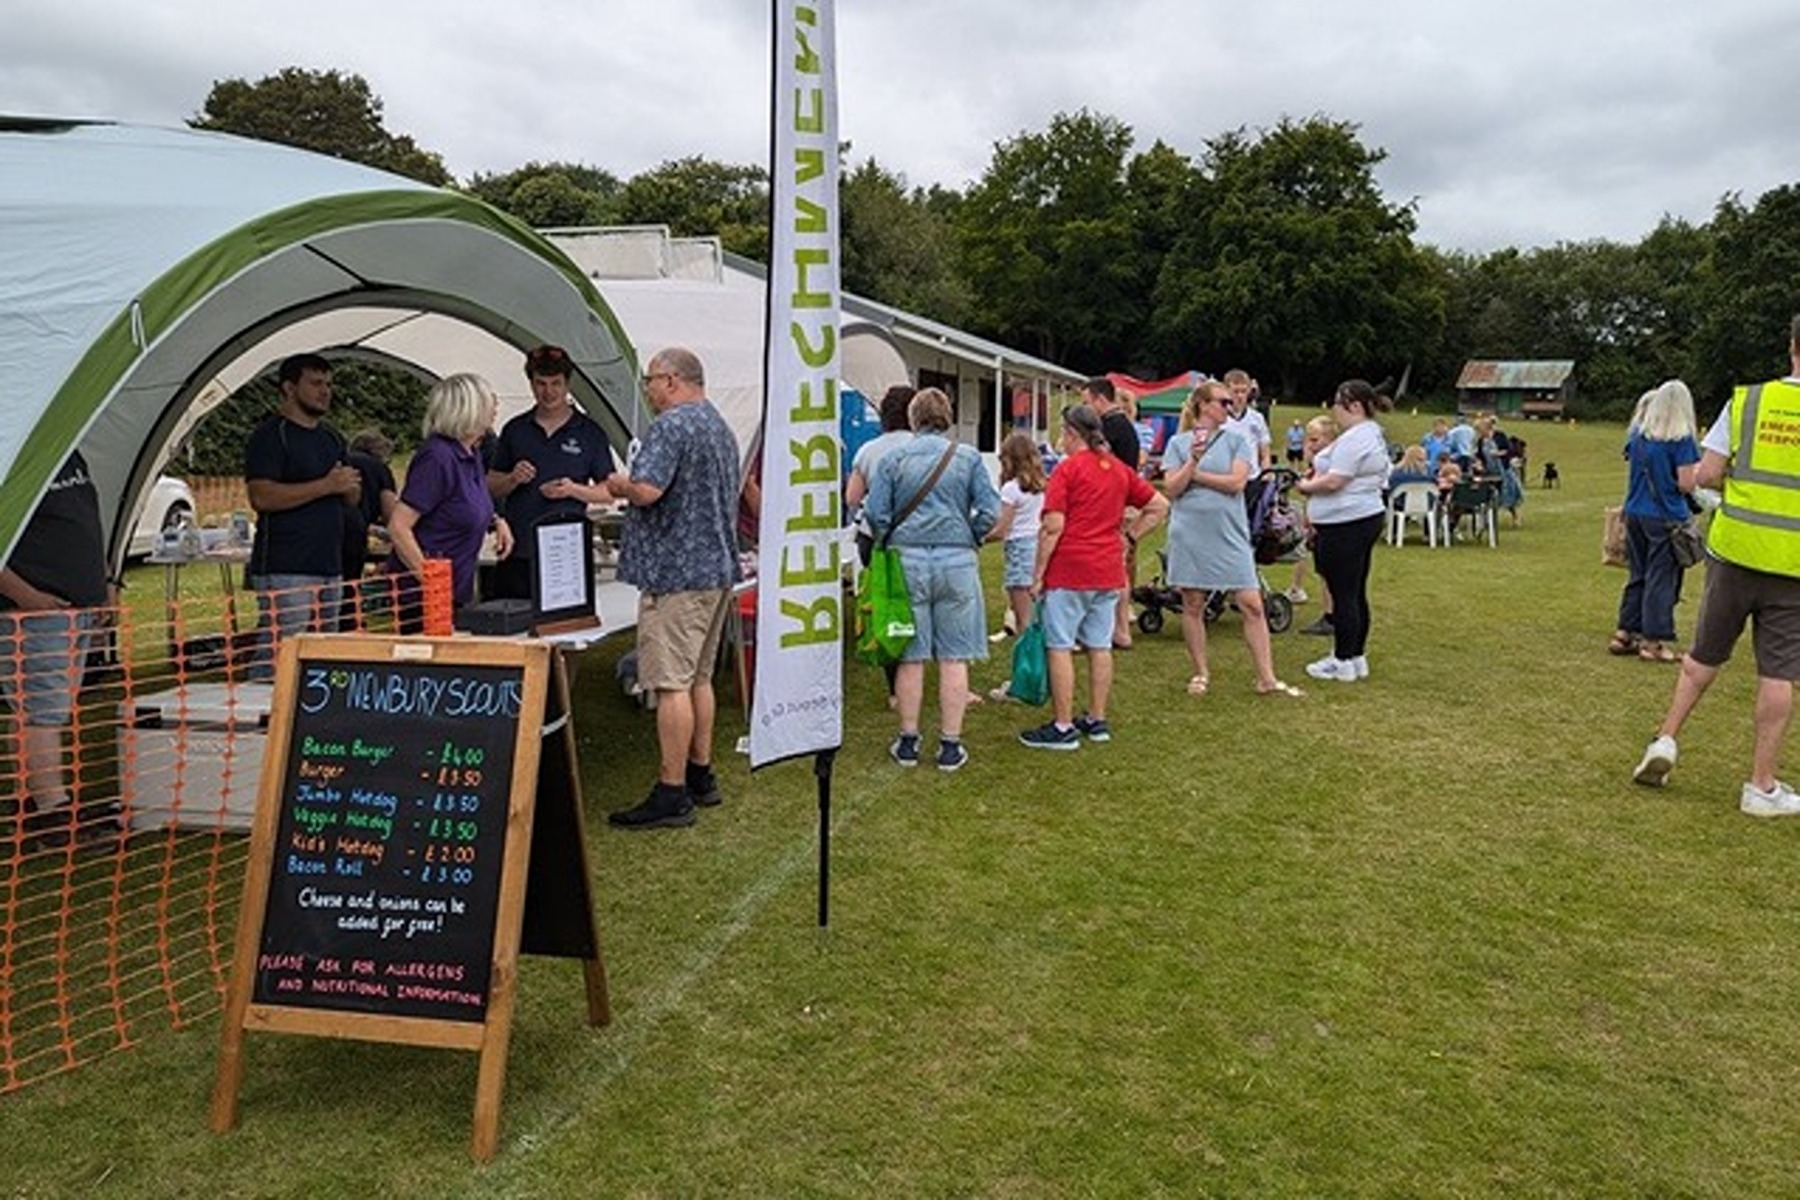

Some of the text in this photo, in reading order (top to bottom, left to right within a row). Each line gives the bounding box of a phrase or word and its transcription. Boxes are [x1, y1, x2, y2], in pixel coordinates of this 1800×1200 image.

[346, 672, 446, 716] NEWBURY
[445, 678, 524, 717] SCOUTS
[302, 737, 346, 755] Bacon
[351, 738, 395, 766] Burger
[299, 760, 345, 788] Burger
[296, 784, 341, 802] Jumbo
[293, 807, 338, 832] Veggie
[287, 855, 327, 874] Bacon
[335, 858, 363, 876] Roll
[298, 887, 466, 914] Cheese and onions can be
[337, 915, 379, 930] added
[381, 917, 405, 938] for
[260, 954, 465, 981] PLEASE ASK FOR ALLERGENS
[277, 979, 481, 1006] AND NUTRITIONAL INFORMATION
